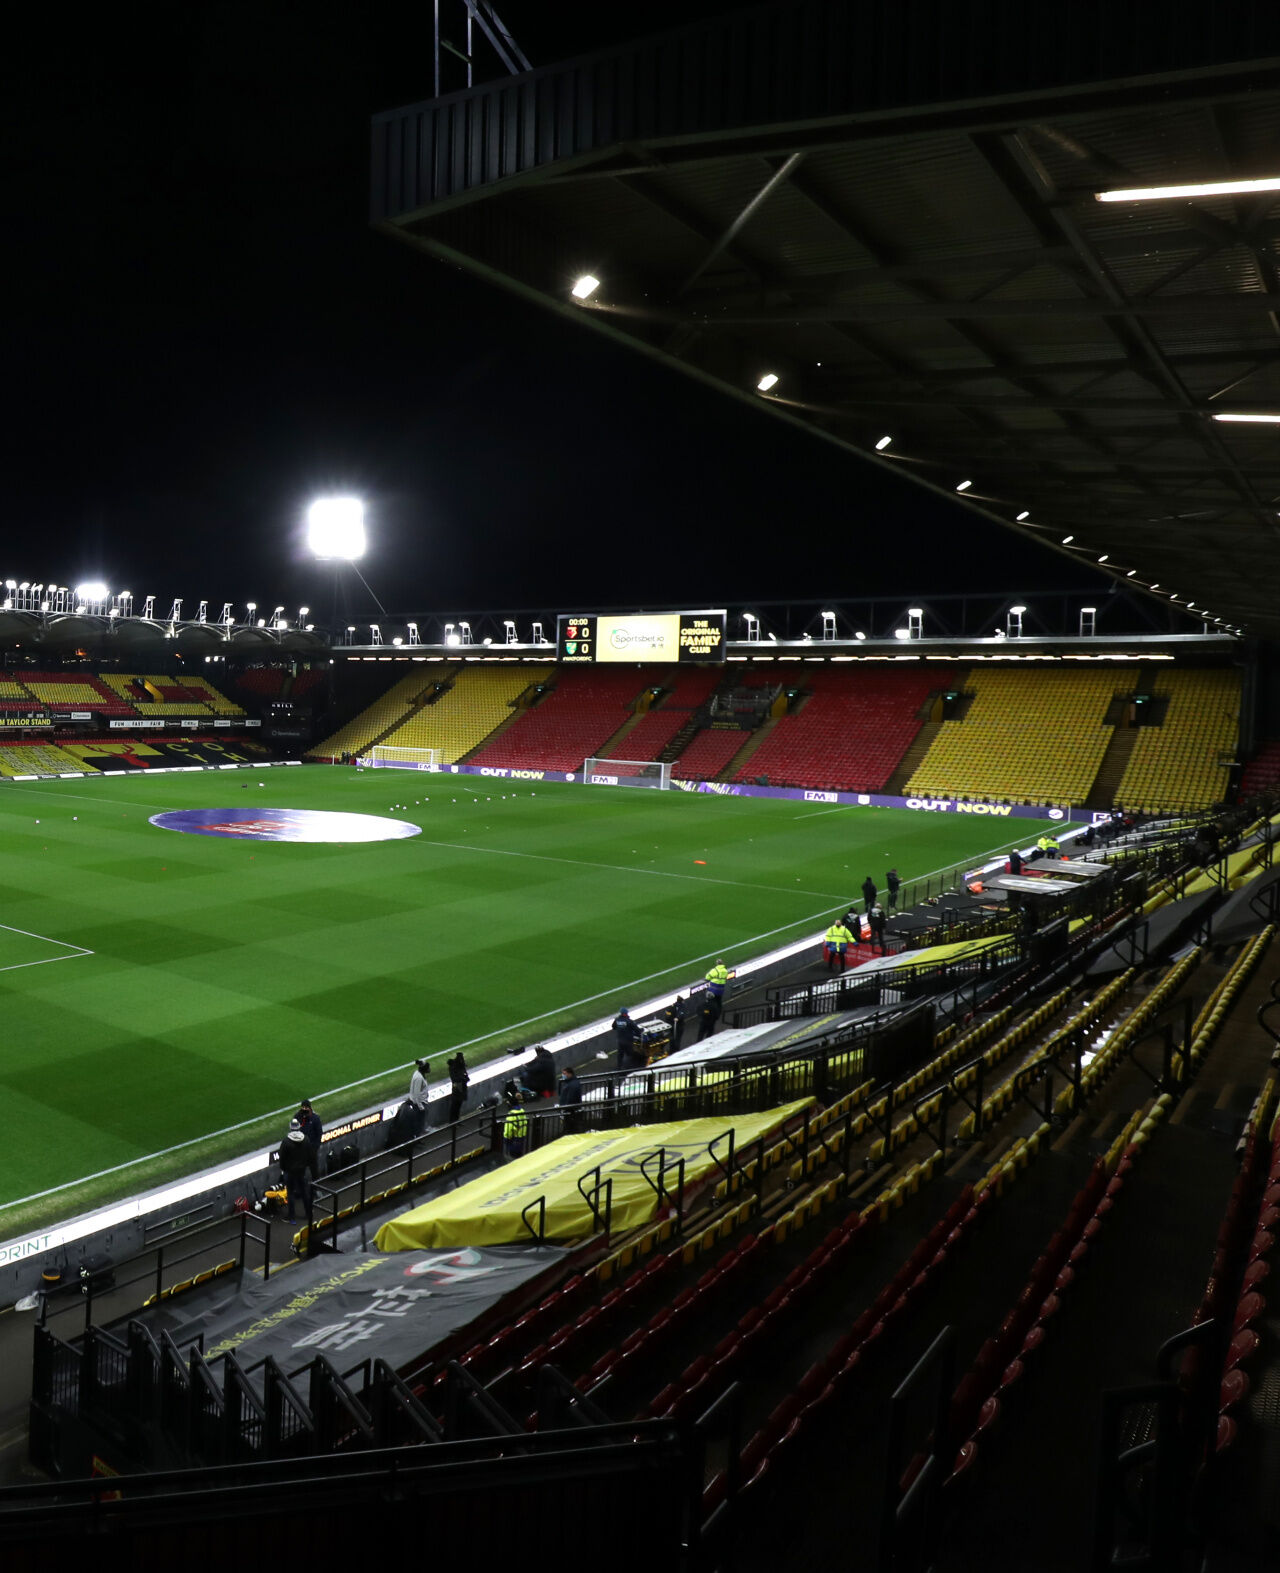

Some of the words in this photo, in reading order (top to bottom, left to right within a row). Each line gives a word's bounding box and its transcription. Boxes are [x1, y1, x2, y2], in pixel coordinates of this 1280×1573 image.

[693, 620, 708, 628] THE
[582, 627, 590, 638] 0
[681, 627, 720, 636] ORIGINAL
[680, 635, 721, 647] FAMILY
[581, 643, 589, 654] 0
[688, 646, 711, 654] CLUB
[6, 718, 30, 726] TAYLOR
[480, 767, 509, 778] OUT
[511, 769, 545, 780] NOW
[906, 798, 950, 811] OUT
[956, 802, 1012, 816] NOW
[320, 1124, 352, 1143] EGIONAL
[352, 1113, 381, 1131] PARTNER
